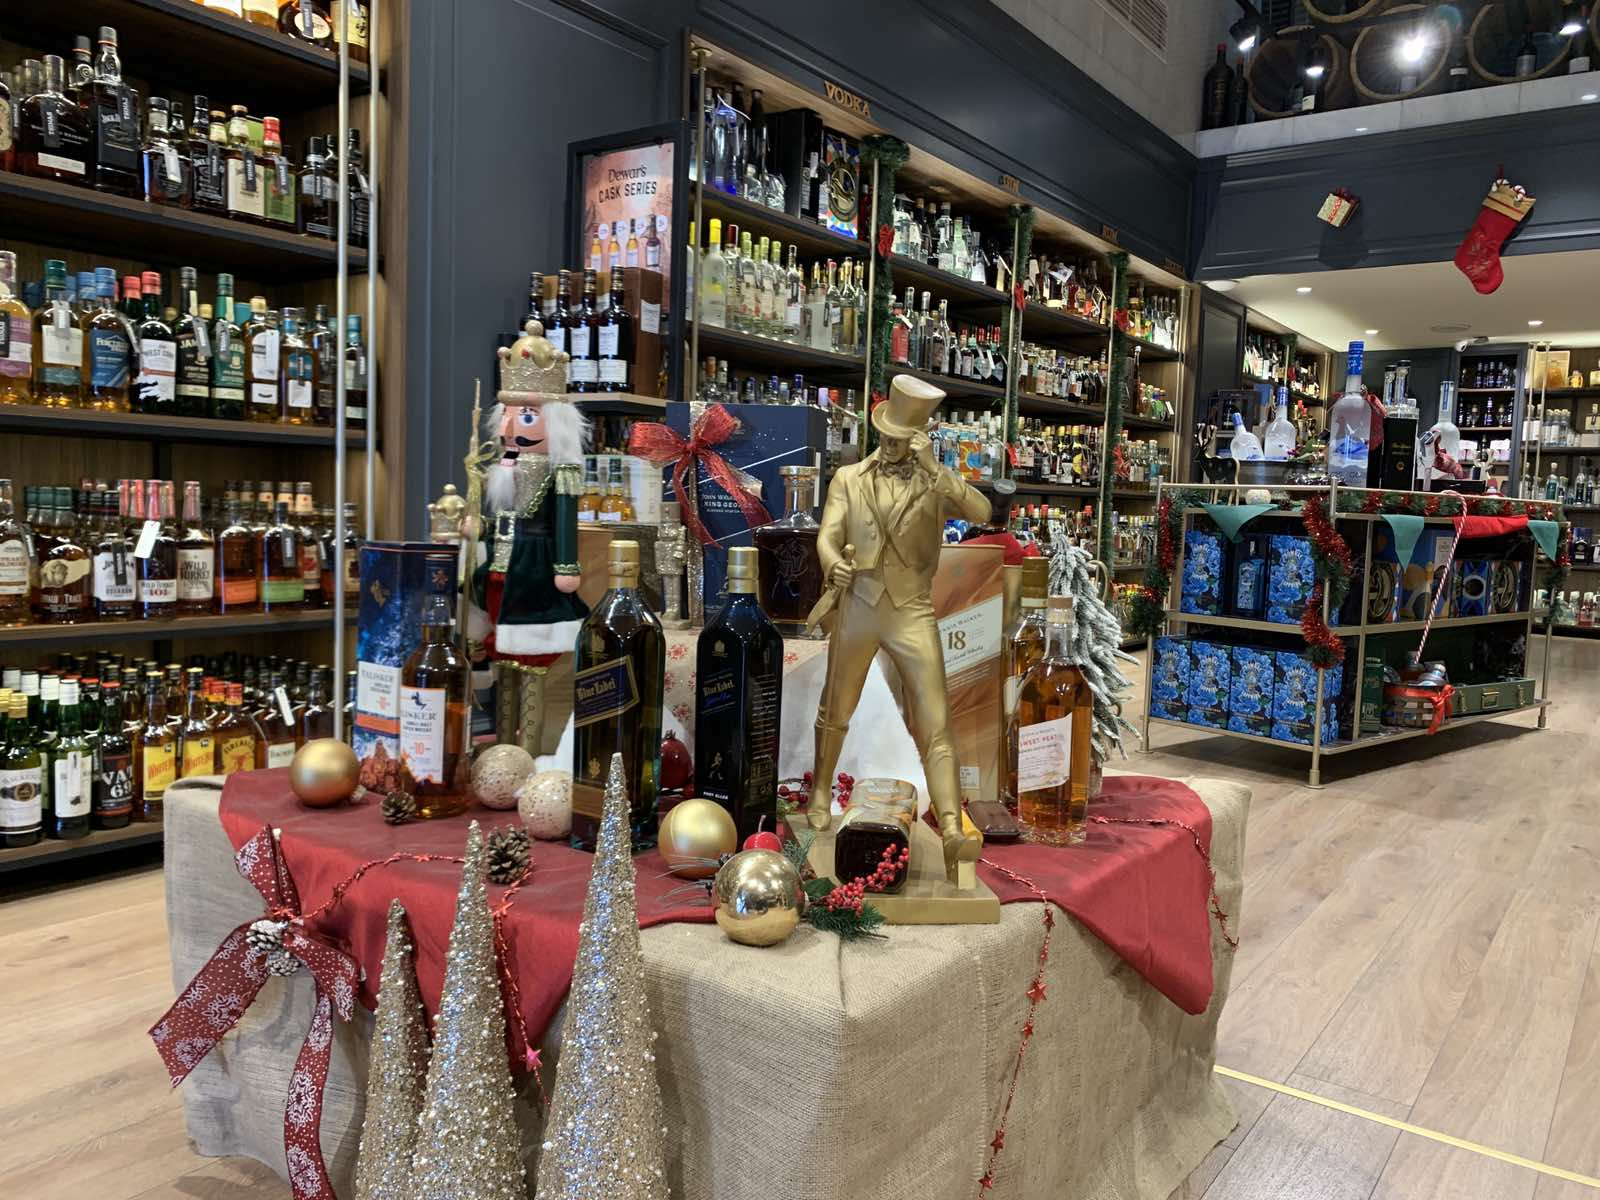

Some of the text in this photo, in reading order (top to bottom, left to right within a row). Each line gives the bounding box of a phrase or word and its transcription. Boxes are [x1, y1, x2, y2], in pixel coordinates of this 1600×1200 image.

[824, 80, 871, 119] VODKA
[608, 164, 648, 183] Dewar's
[598, 181, 657, 203] CASK SERIES
[184, 561, 207, 570] WILD
[180, 570, 210, 580] TURKEY
[947, 630, 966, 650] 18
[575, 687, 595, 701] Blue
[702, 686, 717, 697] Blue
[414, 742, 425, 755] 10
[110, 779, 132, 798] 69
